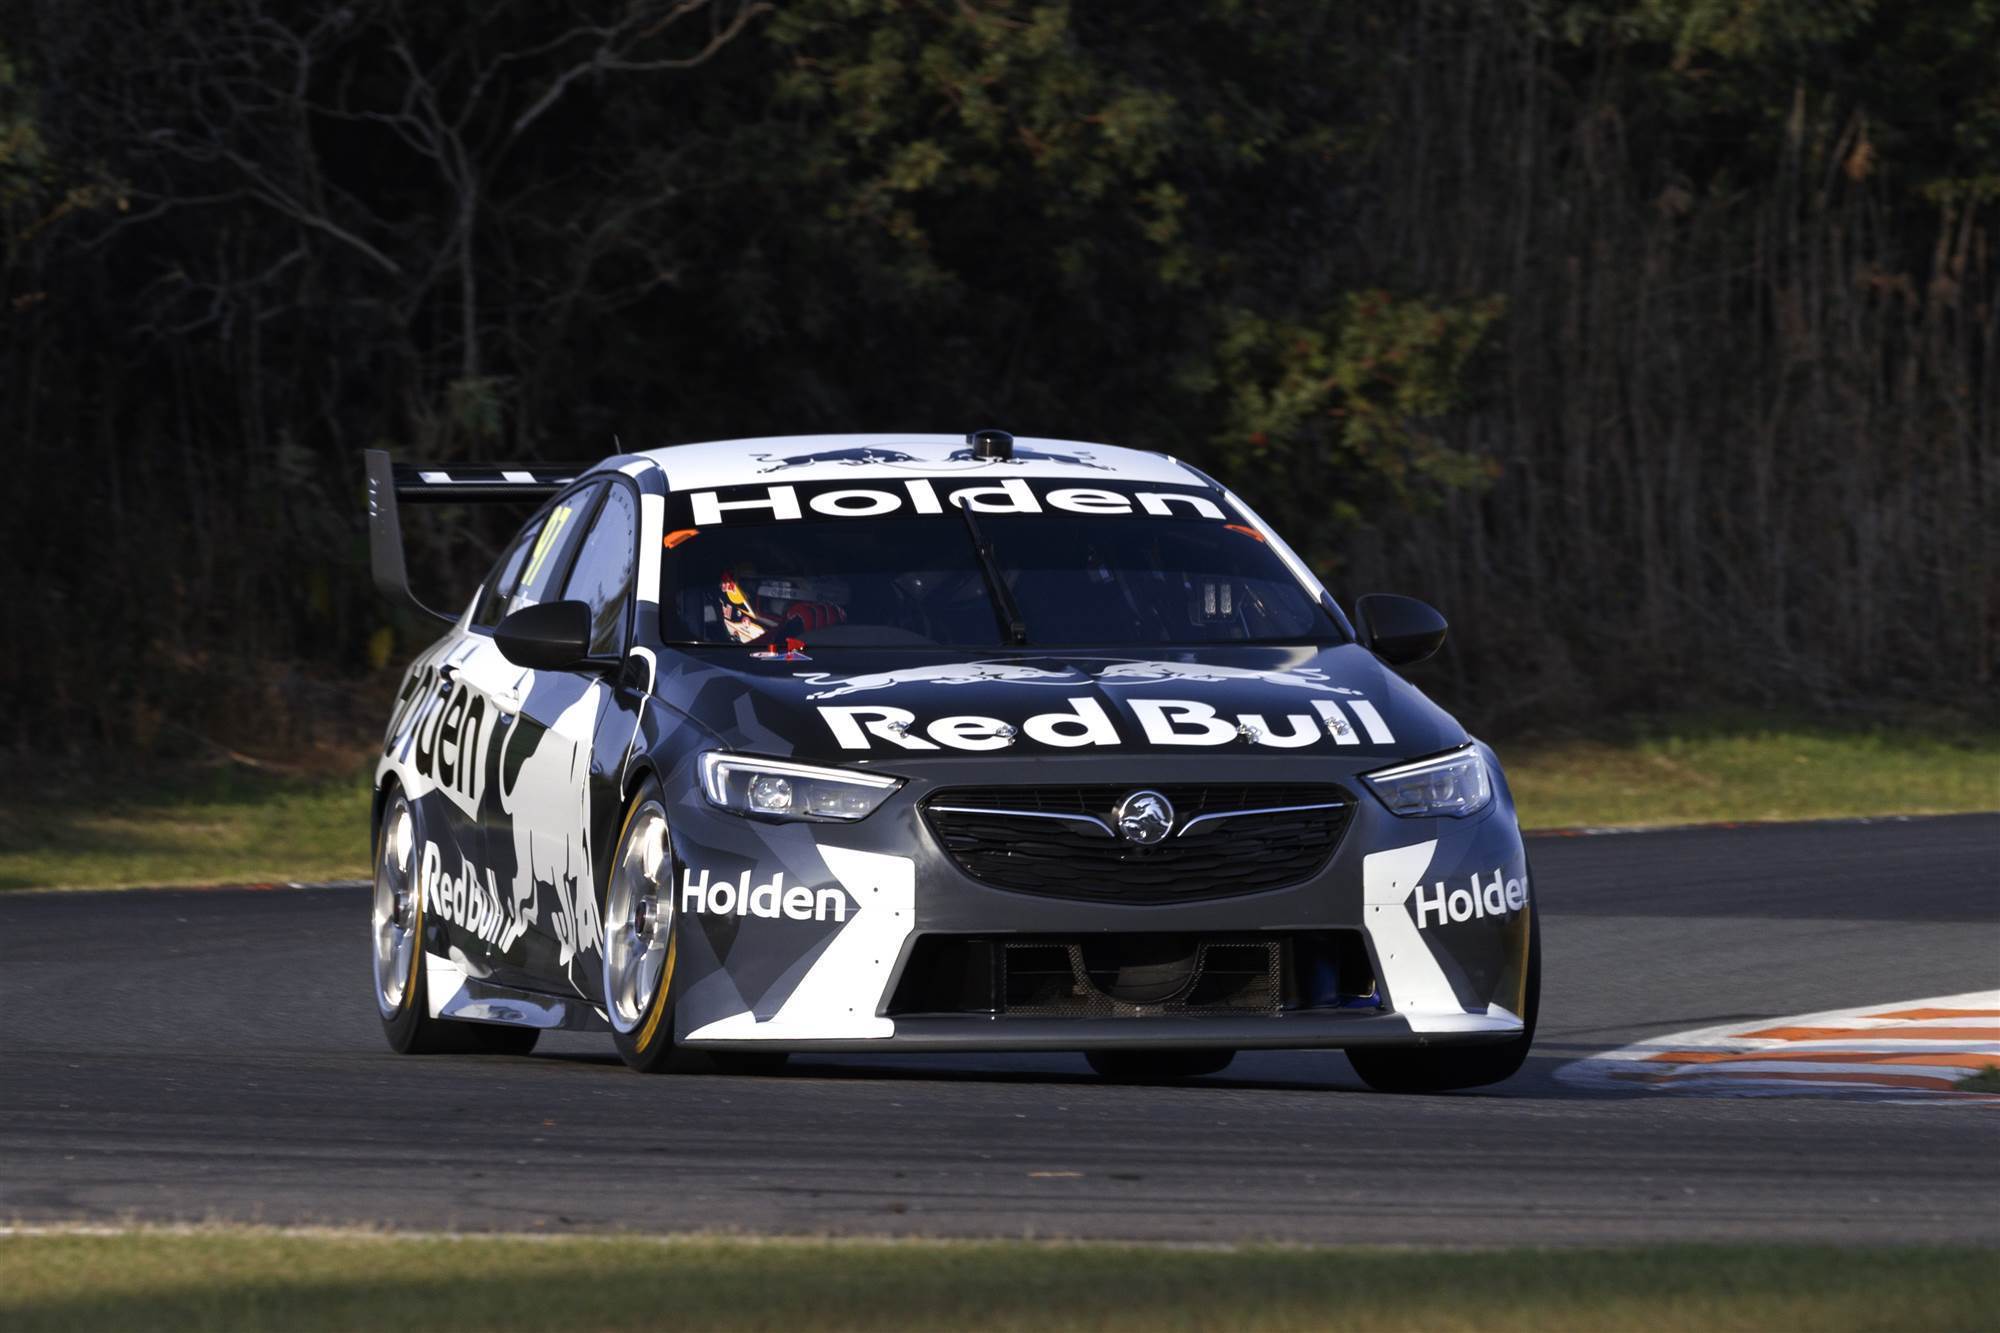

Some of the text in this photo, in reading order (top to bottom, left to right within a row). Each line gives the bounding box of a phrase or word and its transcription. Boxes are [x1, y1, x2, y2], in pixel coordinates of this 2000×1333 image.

[690, 478, 1226, 525] Holden
[816, 697, 1395, 751] Red Bull
[681, 868, 846, 922] Holden
